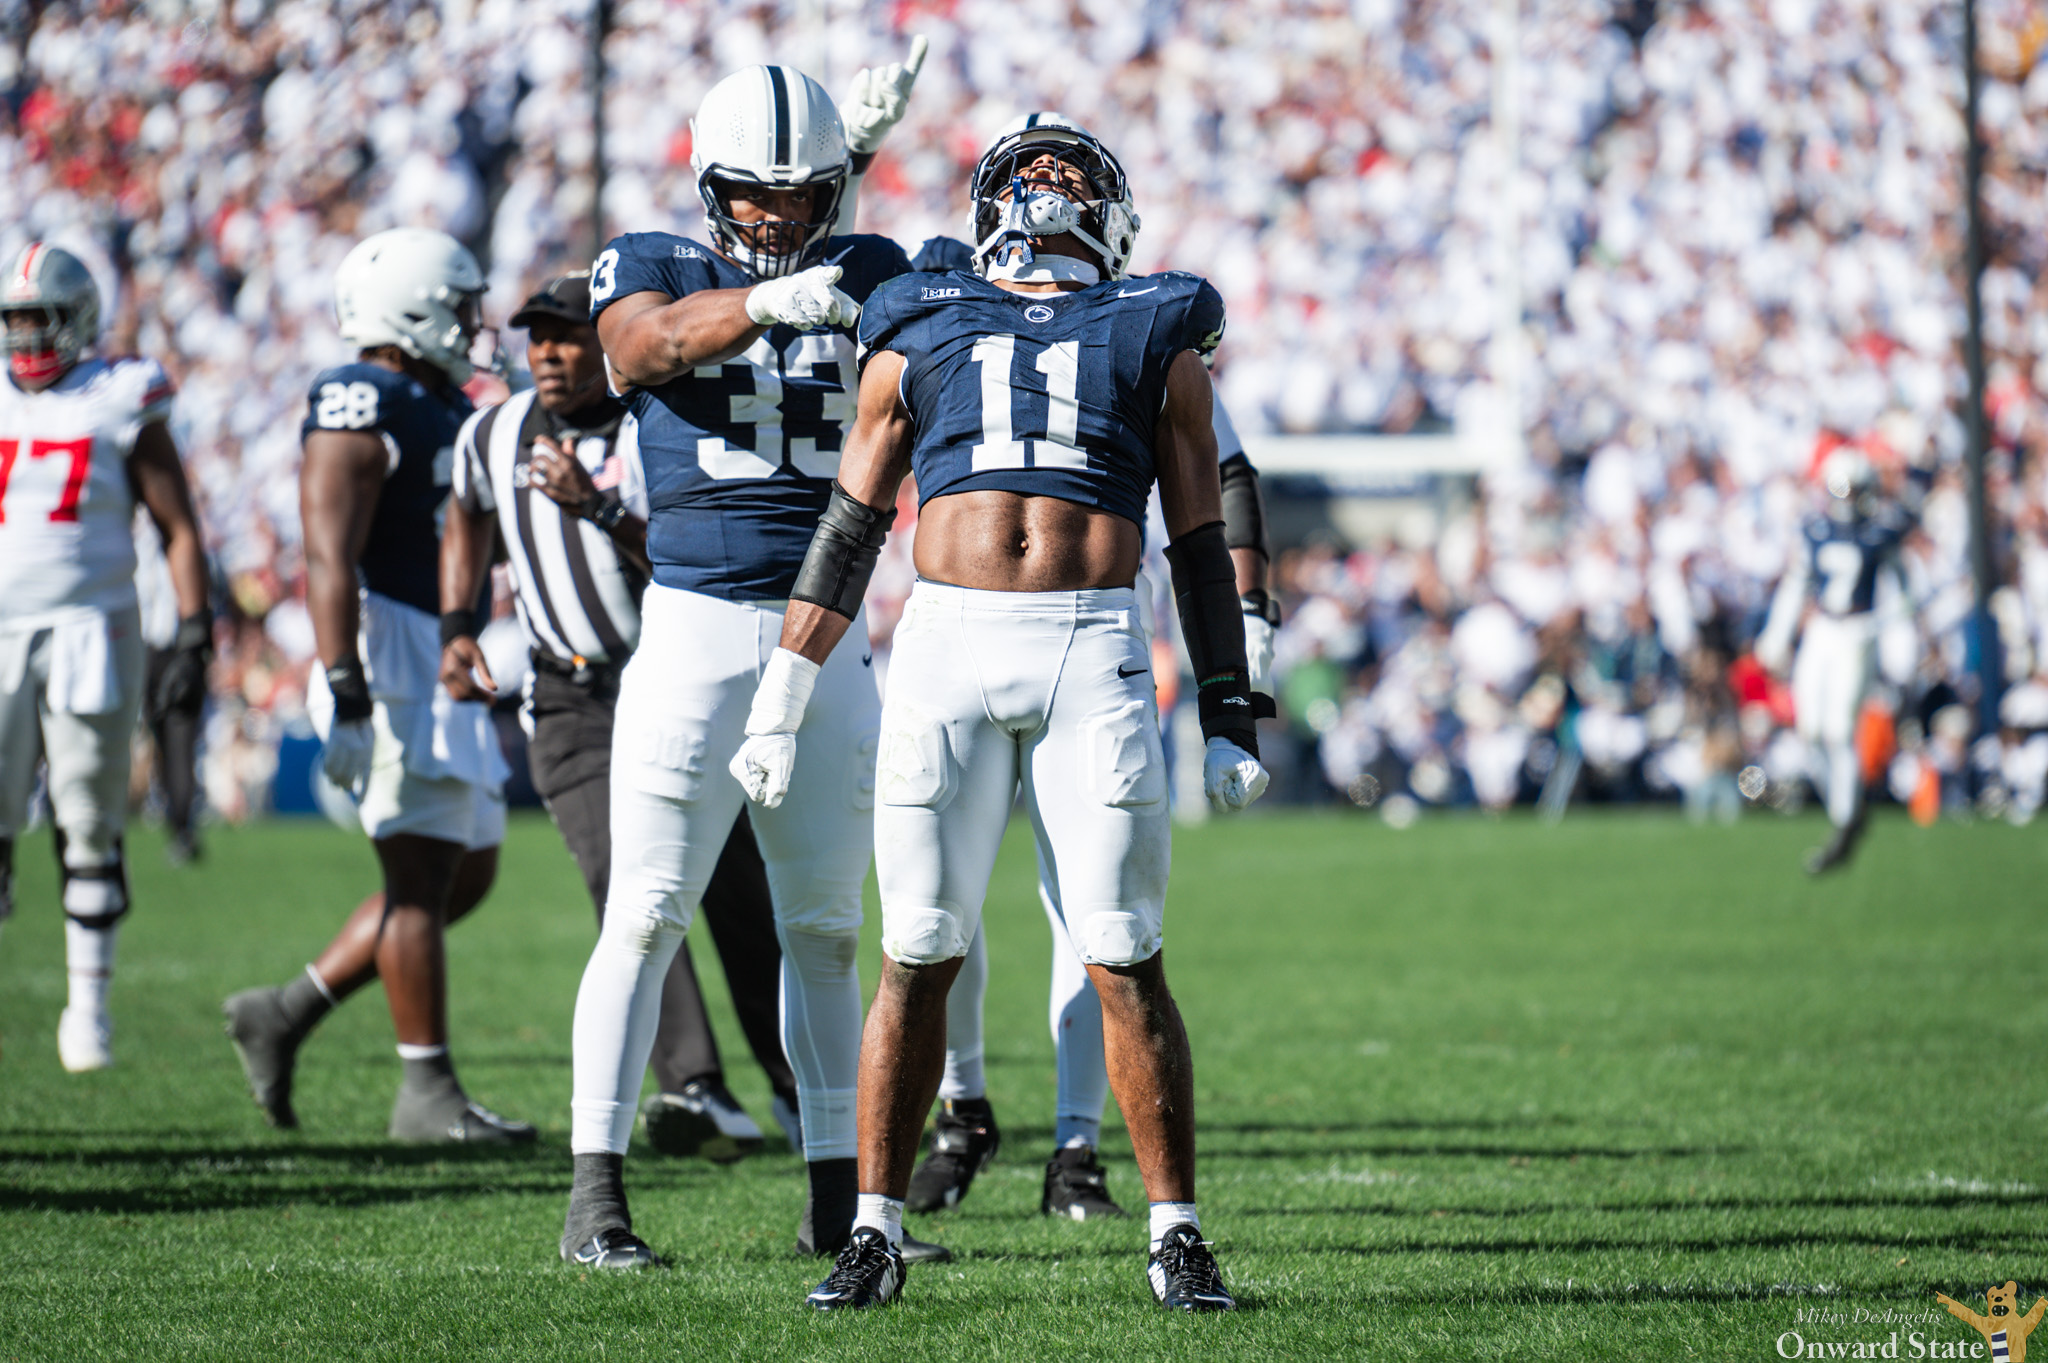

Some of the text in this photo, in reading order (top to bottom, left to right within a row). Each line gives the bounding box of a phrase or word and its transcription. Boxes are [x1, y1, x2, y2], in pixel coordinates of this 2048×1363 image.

[317, 381, 380, 429] 28
[694, 333, 858, 480] 33
[971, 333, 1088, 472] 11
[1817, 541, 1863, 613] 7
